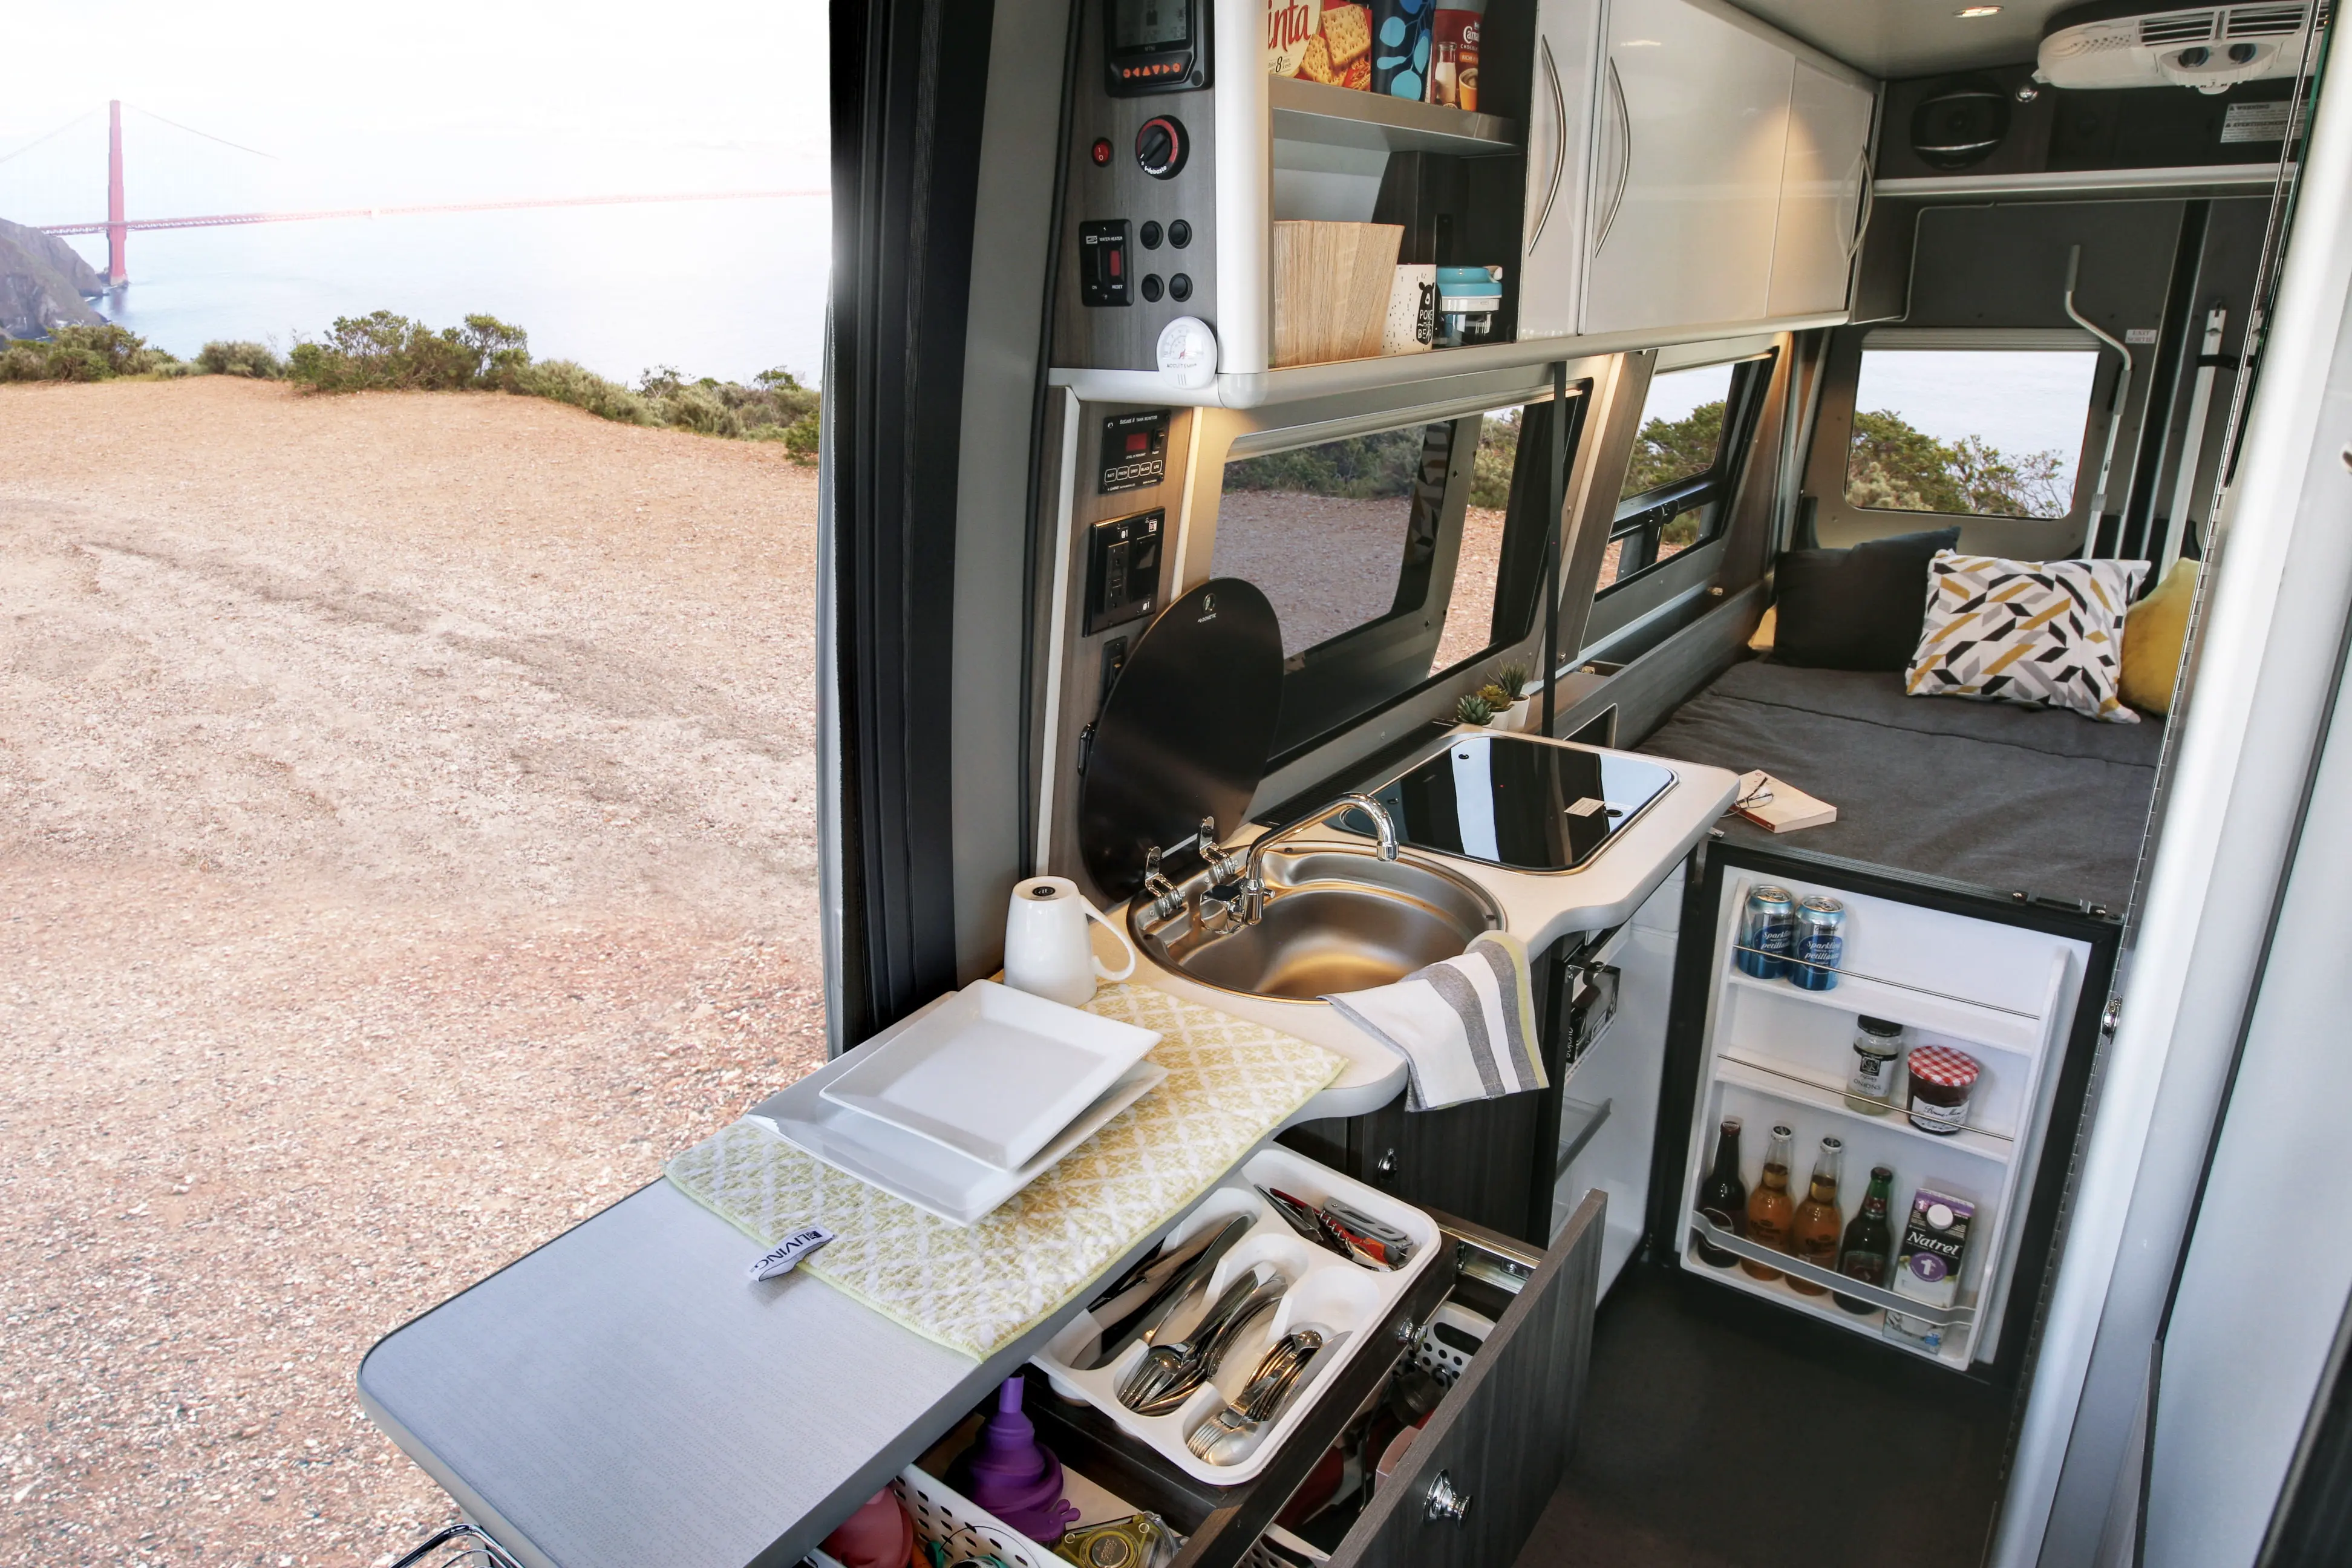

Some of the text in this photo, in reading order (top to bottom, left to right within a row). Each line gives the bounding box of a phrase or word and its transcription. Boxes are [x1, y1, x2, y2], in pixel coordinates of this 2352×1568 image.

[1276, 56, 1282, 72] 8
[1854, 1079, 1881, 1089] ONIONS
[1907, 1231, 1959, 1255] Natrel
